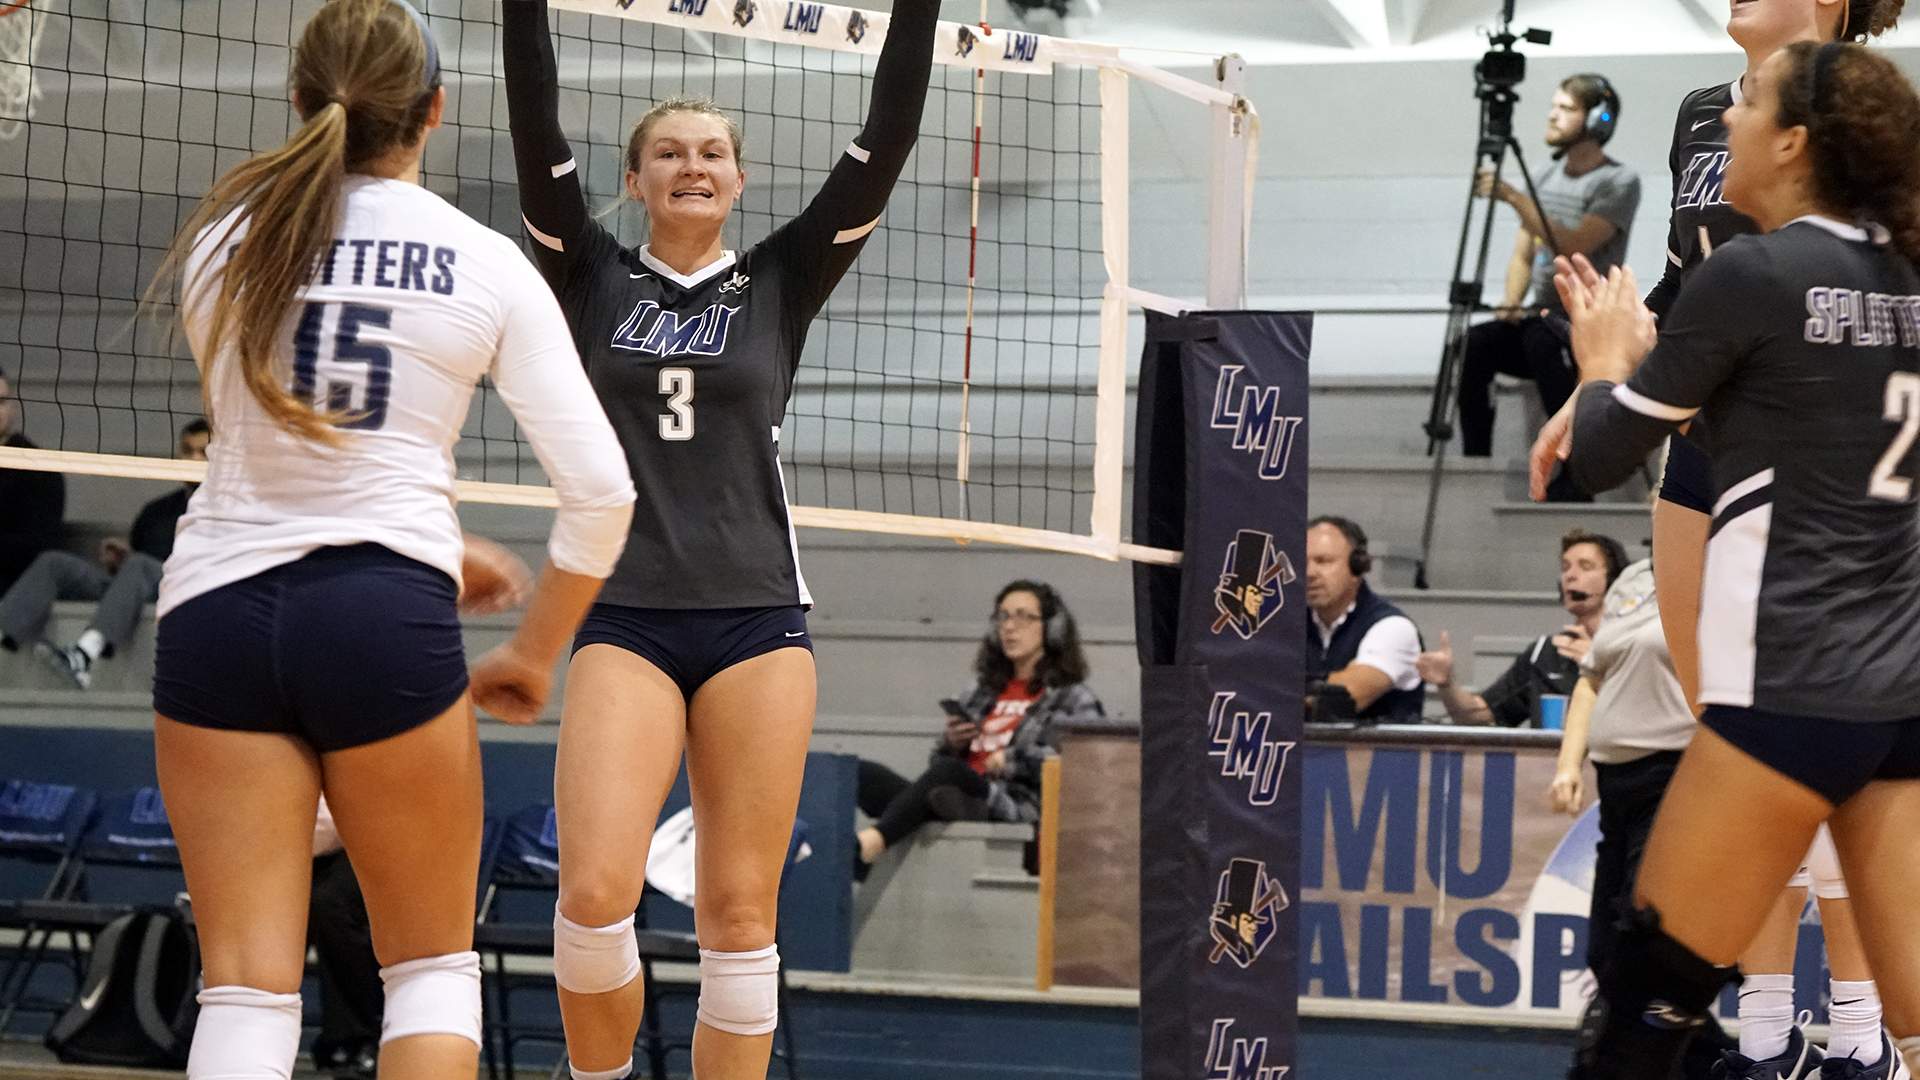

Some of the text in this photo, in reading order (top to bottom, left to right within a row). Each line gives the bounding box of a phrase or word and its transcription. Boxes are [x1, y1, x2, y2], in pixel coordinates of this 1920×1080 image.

[783, 1, 825, 36] LMU
[1002, 31, 1039, 62] LMU
[1675, 151, 1735, 211] LM
[611, 300, 743, 358] LMU
[292, 301, 393, 431] 15
[658, 366, 695, 441] 3
[1210, 365, 1303, 480] LMU
[1208, 691, 1297, 806] LMU
[1203, 1018, 1290, 1080] LM
